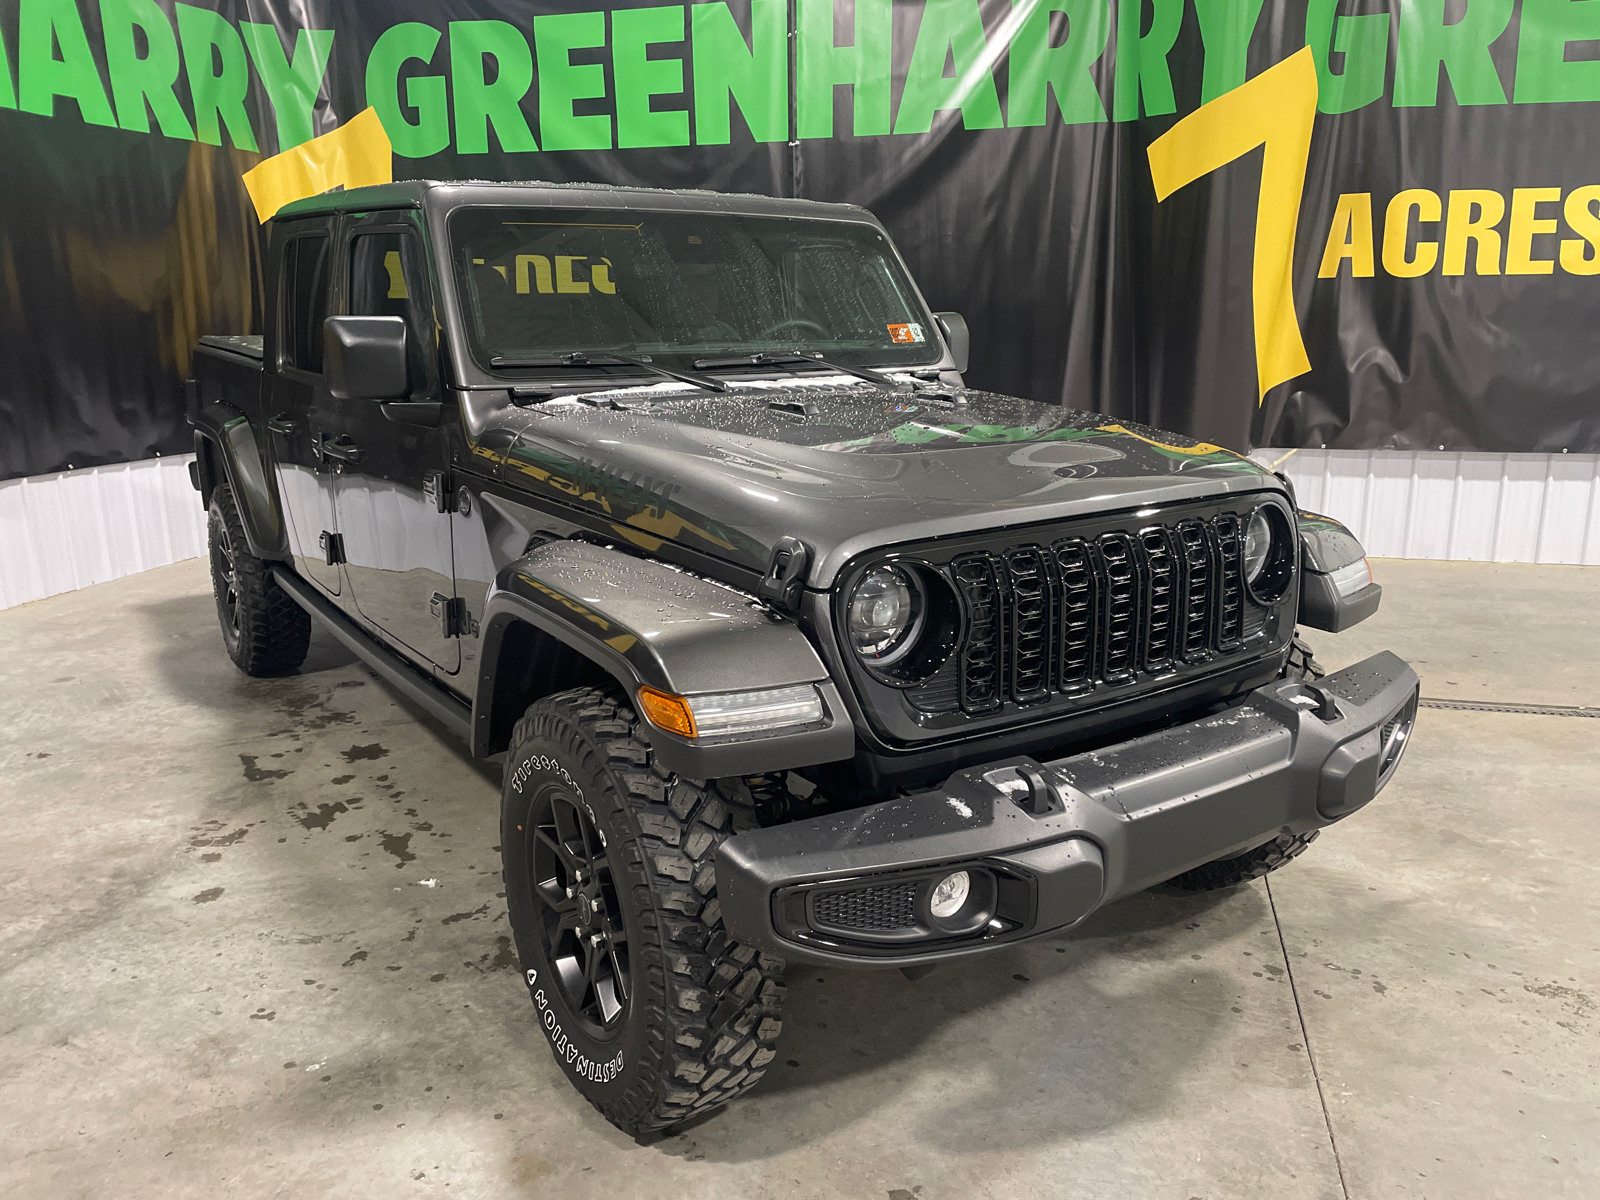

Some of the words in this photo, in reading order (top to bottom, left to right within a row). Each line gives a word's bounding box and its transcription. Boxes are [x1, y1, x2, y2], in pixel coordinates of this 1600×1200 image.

[0, 0, 335, 153] ARRY
[365, 0, 789, 158] GREEN
[797, 0, 1262, 139] HARRY
[1146, 44, 1318, 407] 7
[1317, 185, 1600, 279] ACRES
[511, 755, 596, 824] Firestone
[534, 989, 624, 1083] DESTINATION
